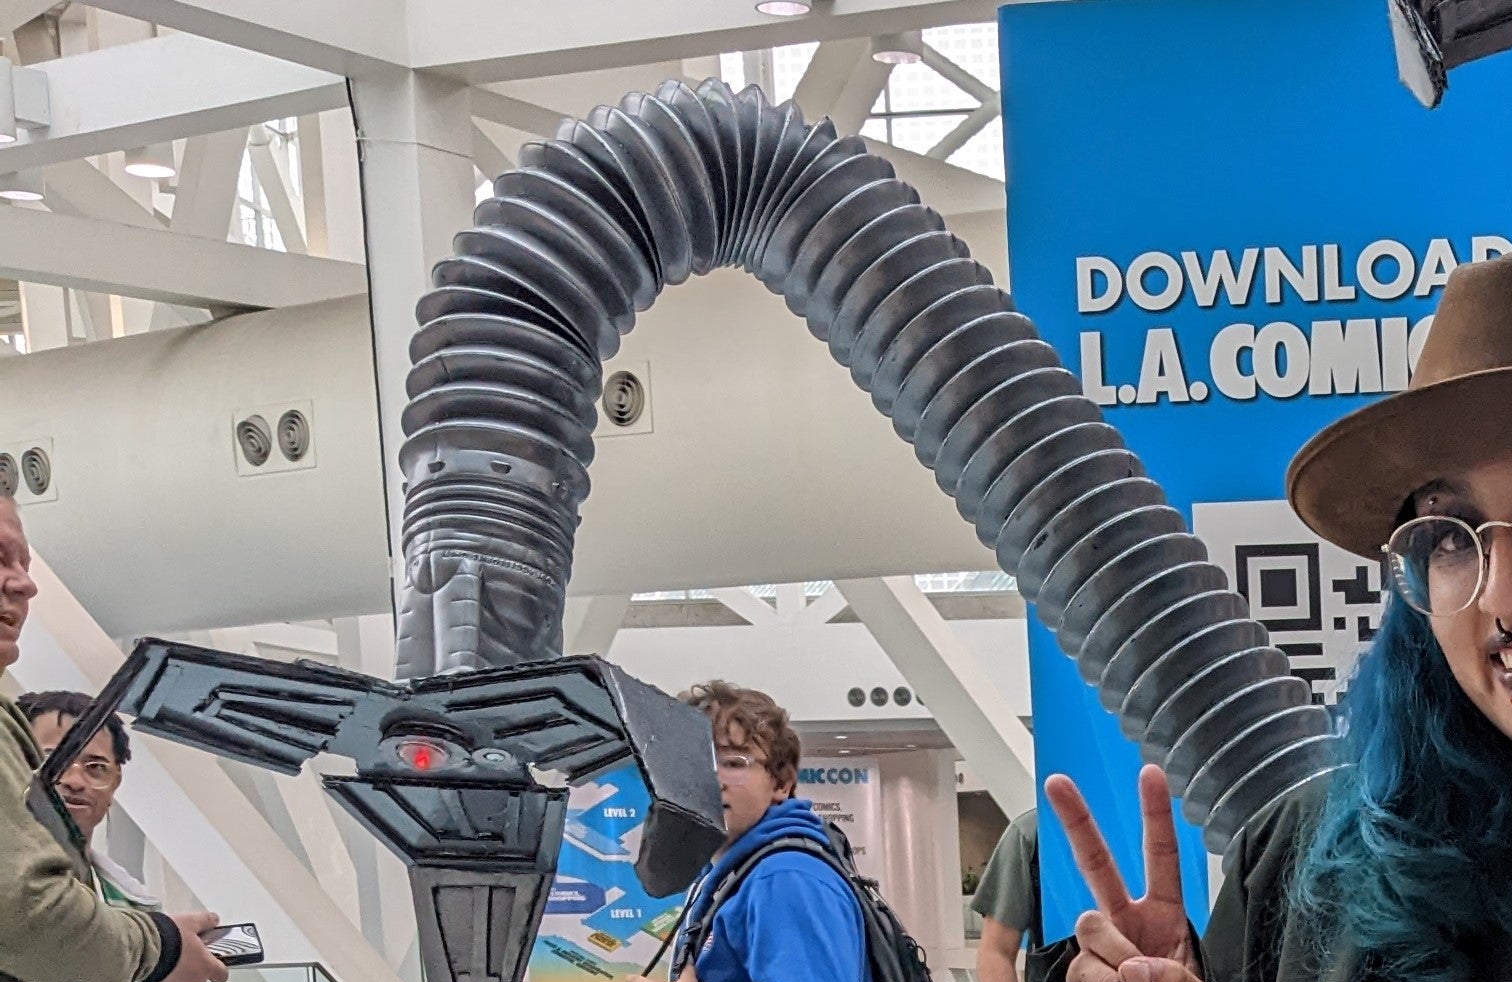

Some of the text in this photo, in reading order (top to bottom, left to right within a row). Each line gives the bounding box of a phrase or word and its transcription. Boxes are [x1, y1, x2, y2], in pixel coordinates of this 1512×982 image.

[603, 808, 636, 818] LEVEL 2
[610, 908, 643, 918] LEVEL 1
